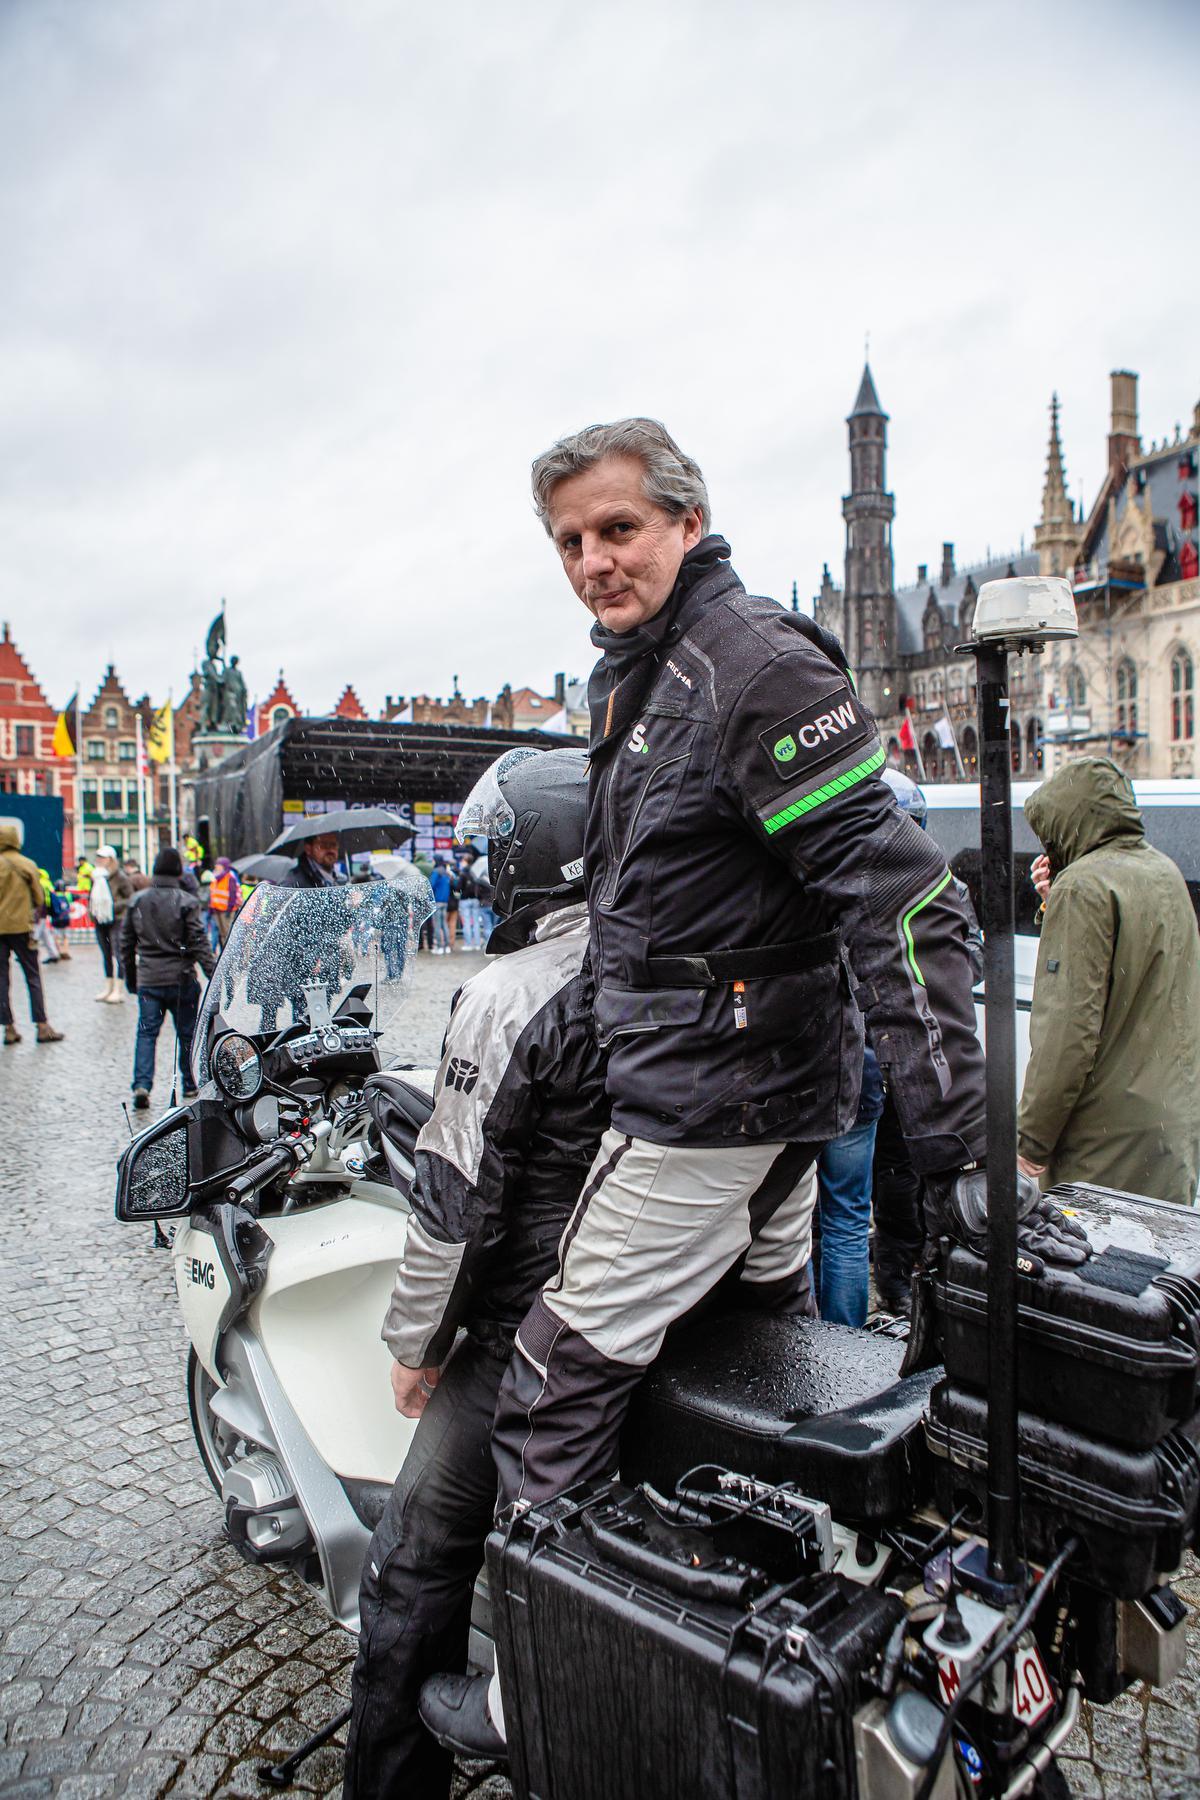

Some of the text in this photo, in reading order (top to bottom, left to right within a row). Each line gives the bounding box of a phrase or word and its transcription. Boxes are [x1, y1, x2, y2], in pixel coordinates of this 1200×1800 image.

[666, 659, 692, 690] RICHA
[776, 700, 857, 757] vrt CRW
[192, 1257, 216, 1290] EMG
